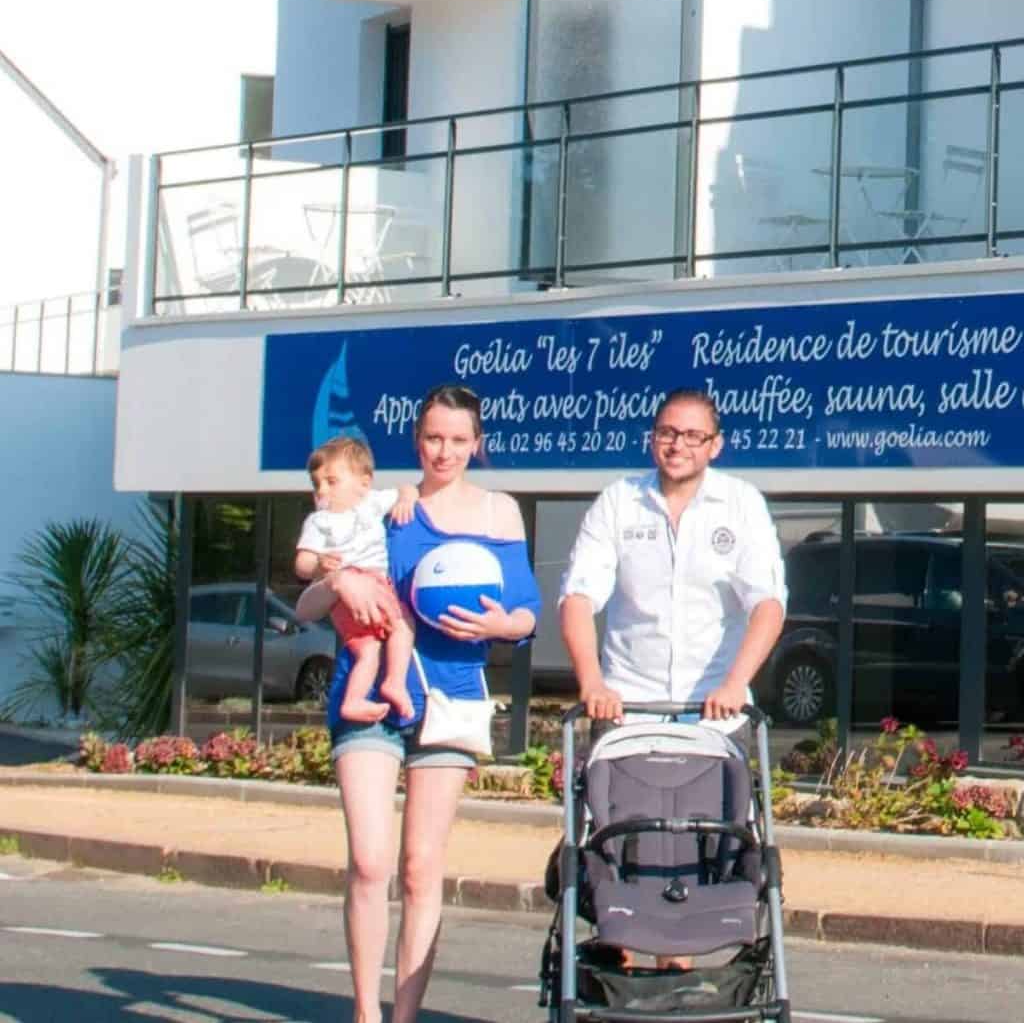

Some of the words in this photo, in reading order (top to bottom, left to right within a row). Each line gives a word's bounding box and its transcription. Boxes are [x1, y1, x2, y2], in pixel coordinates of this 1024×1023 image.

[454, 338, 533, 379] Goélia
[587, 337, 600, 372] 7
[691, 325, 833, 368] Résidence
[836, 320, 878, 360] de
[882, 321, 1023, 358] tourisme
[533, 393, 592, 419] avec
[824, 384, 926, 417] sauna,
[937, 368, 1017, 414] salle
[510, 433, 529, 452] 02
[534, 432, 552, 452] 96
[557, 432, 577, 452] 45
[581, 432, 601, 452] 20
[605, 431, 626, 452] 20
[731, 429, 751, 449] 45
[757, 428, 779, 449] 22
[784, 428, 806, 449] 21
[826, 423, 991, 456] www.goelia.com
